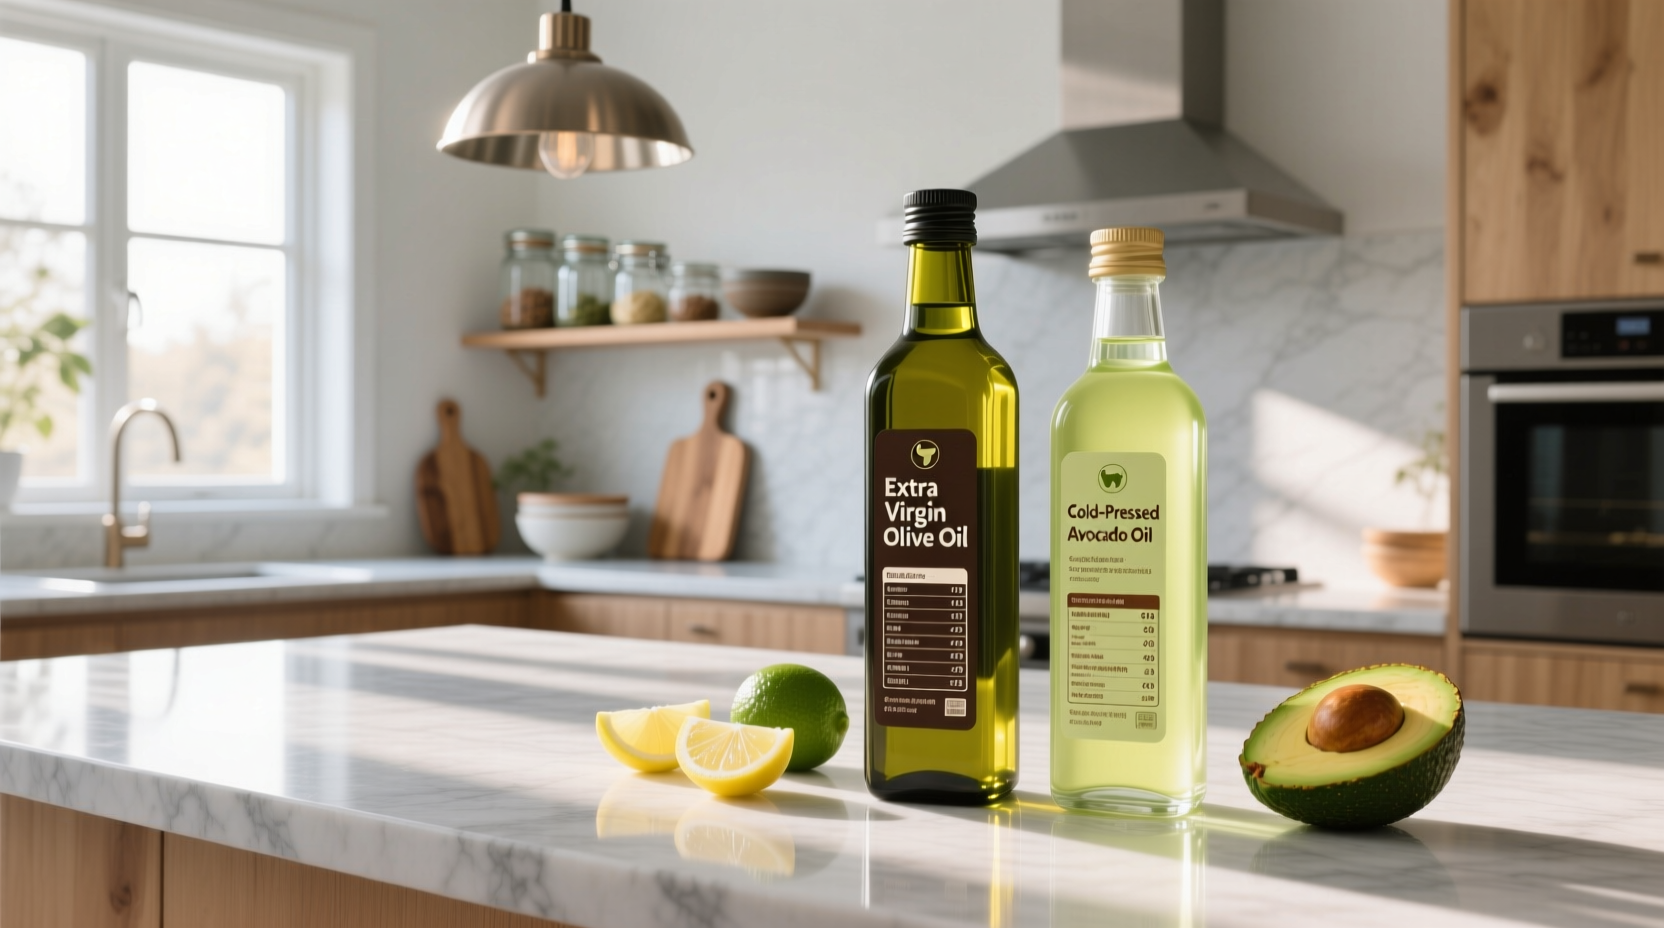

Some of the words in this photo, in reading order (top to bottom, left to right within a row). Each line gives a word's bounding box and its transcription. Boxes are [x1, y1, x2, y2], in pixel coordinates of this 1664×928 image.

[885, 477, 938, 497] Extra
[884, 500, 946, 528] Virgin
[1067, 503, 1160, 520] Cold-Pressed
[883, 526, 934, 547] Olive
[938, 525, 968, 548] Oil
[1067, 526, 1128, 542] Avocado
[1131, 526, 1153, 543] Oil
